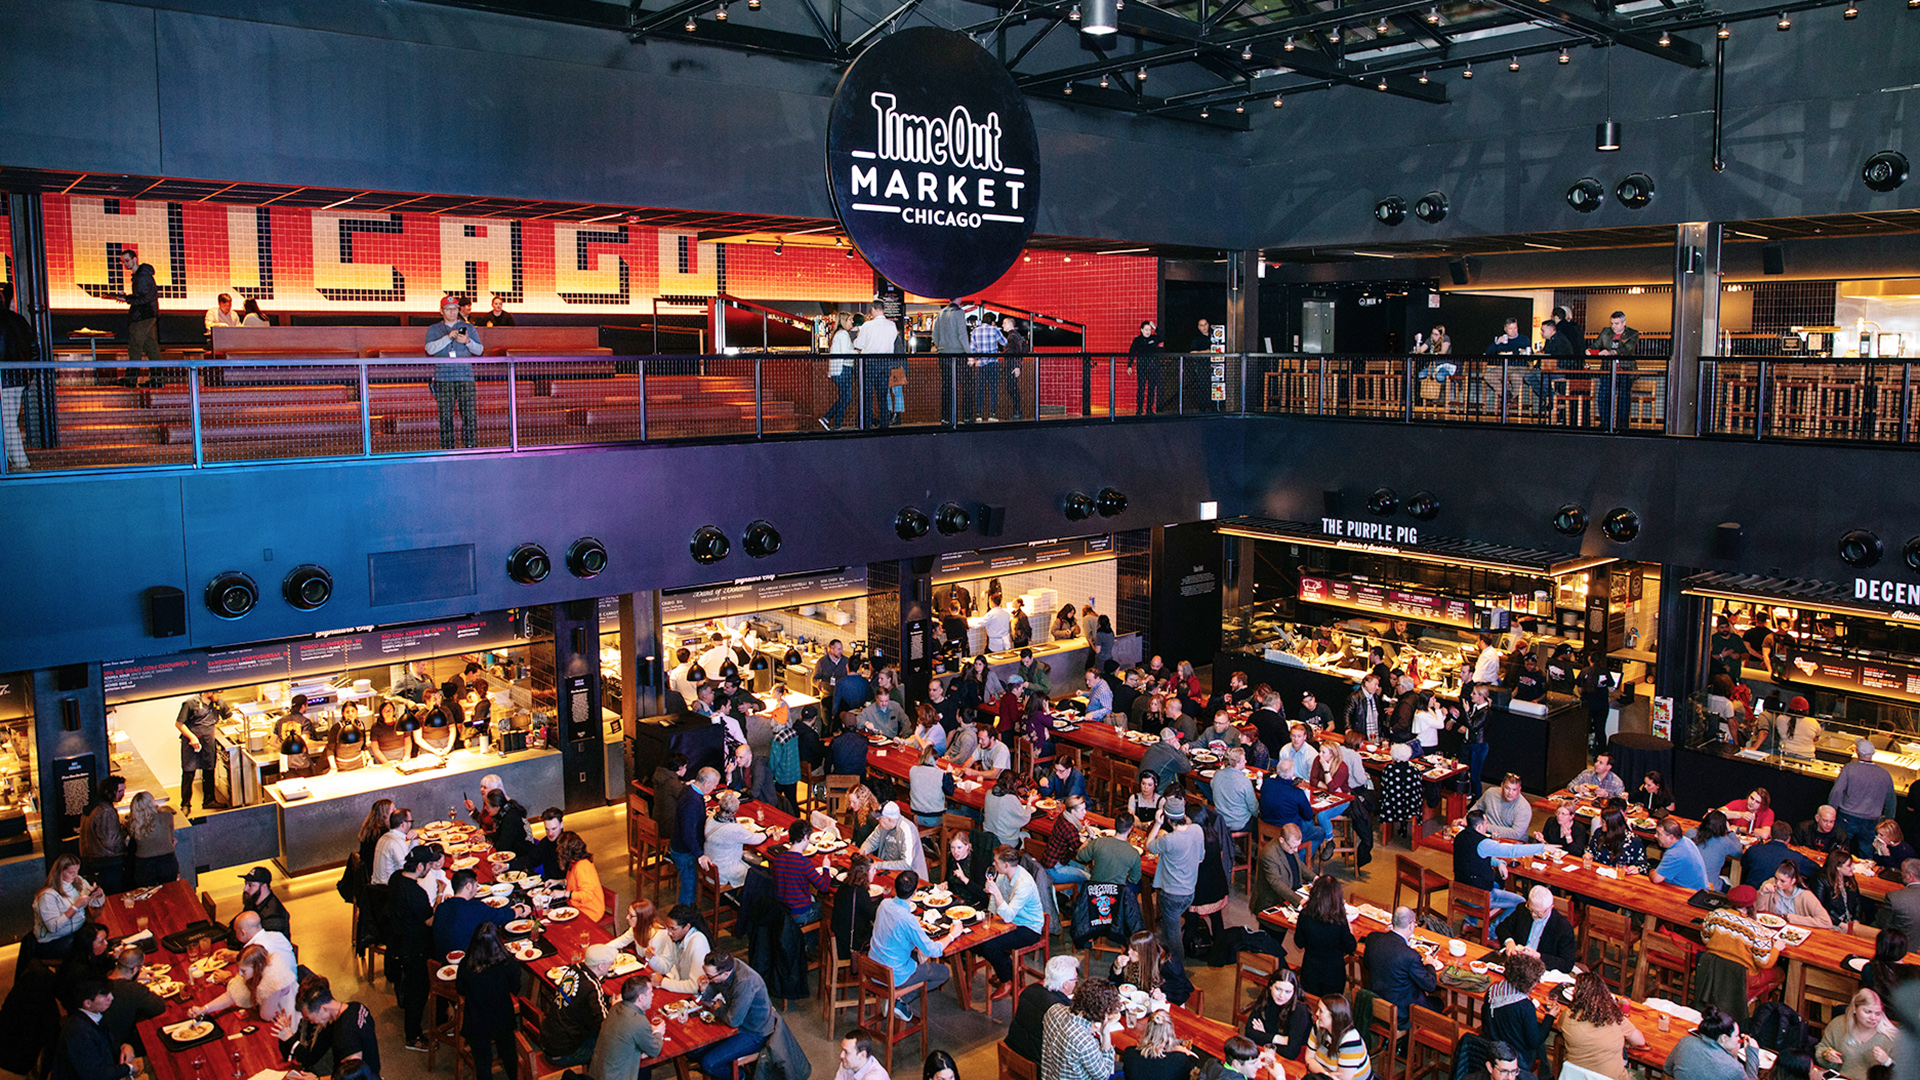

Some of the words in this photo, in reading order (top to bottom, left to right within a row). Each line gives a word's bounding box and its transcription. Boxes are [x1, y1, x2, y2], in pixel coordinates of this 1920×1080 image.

[871, 91, 948, 166] Time
[948, 105, 1003, 171] Out
[851, 164, 1025, 209] MARKET
[902, 207, 982, 228] CHICAGO
[68, 194, 726, 306] HICAGO
[1321, 517, 1343, 535] THE
[1347, 520, 1392, 541] PURPLE
[1396, 526, 1418, 544] PIG
[1854, 577, 1920, 606] DECEN
[1891, 610, 1920, 621] Italia
